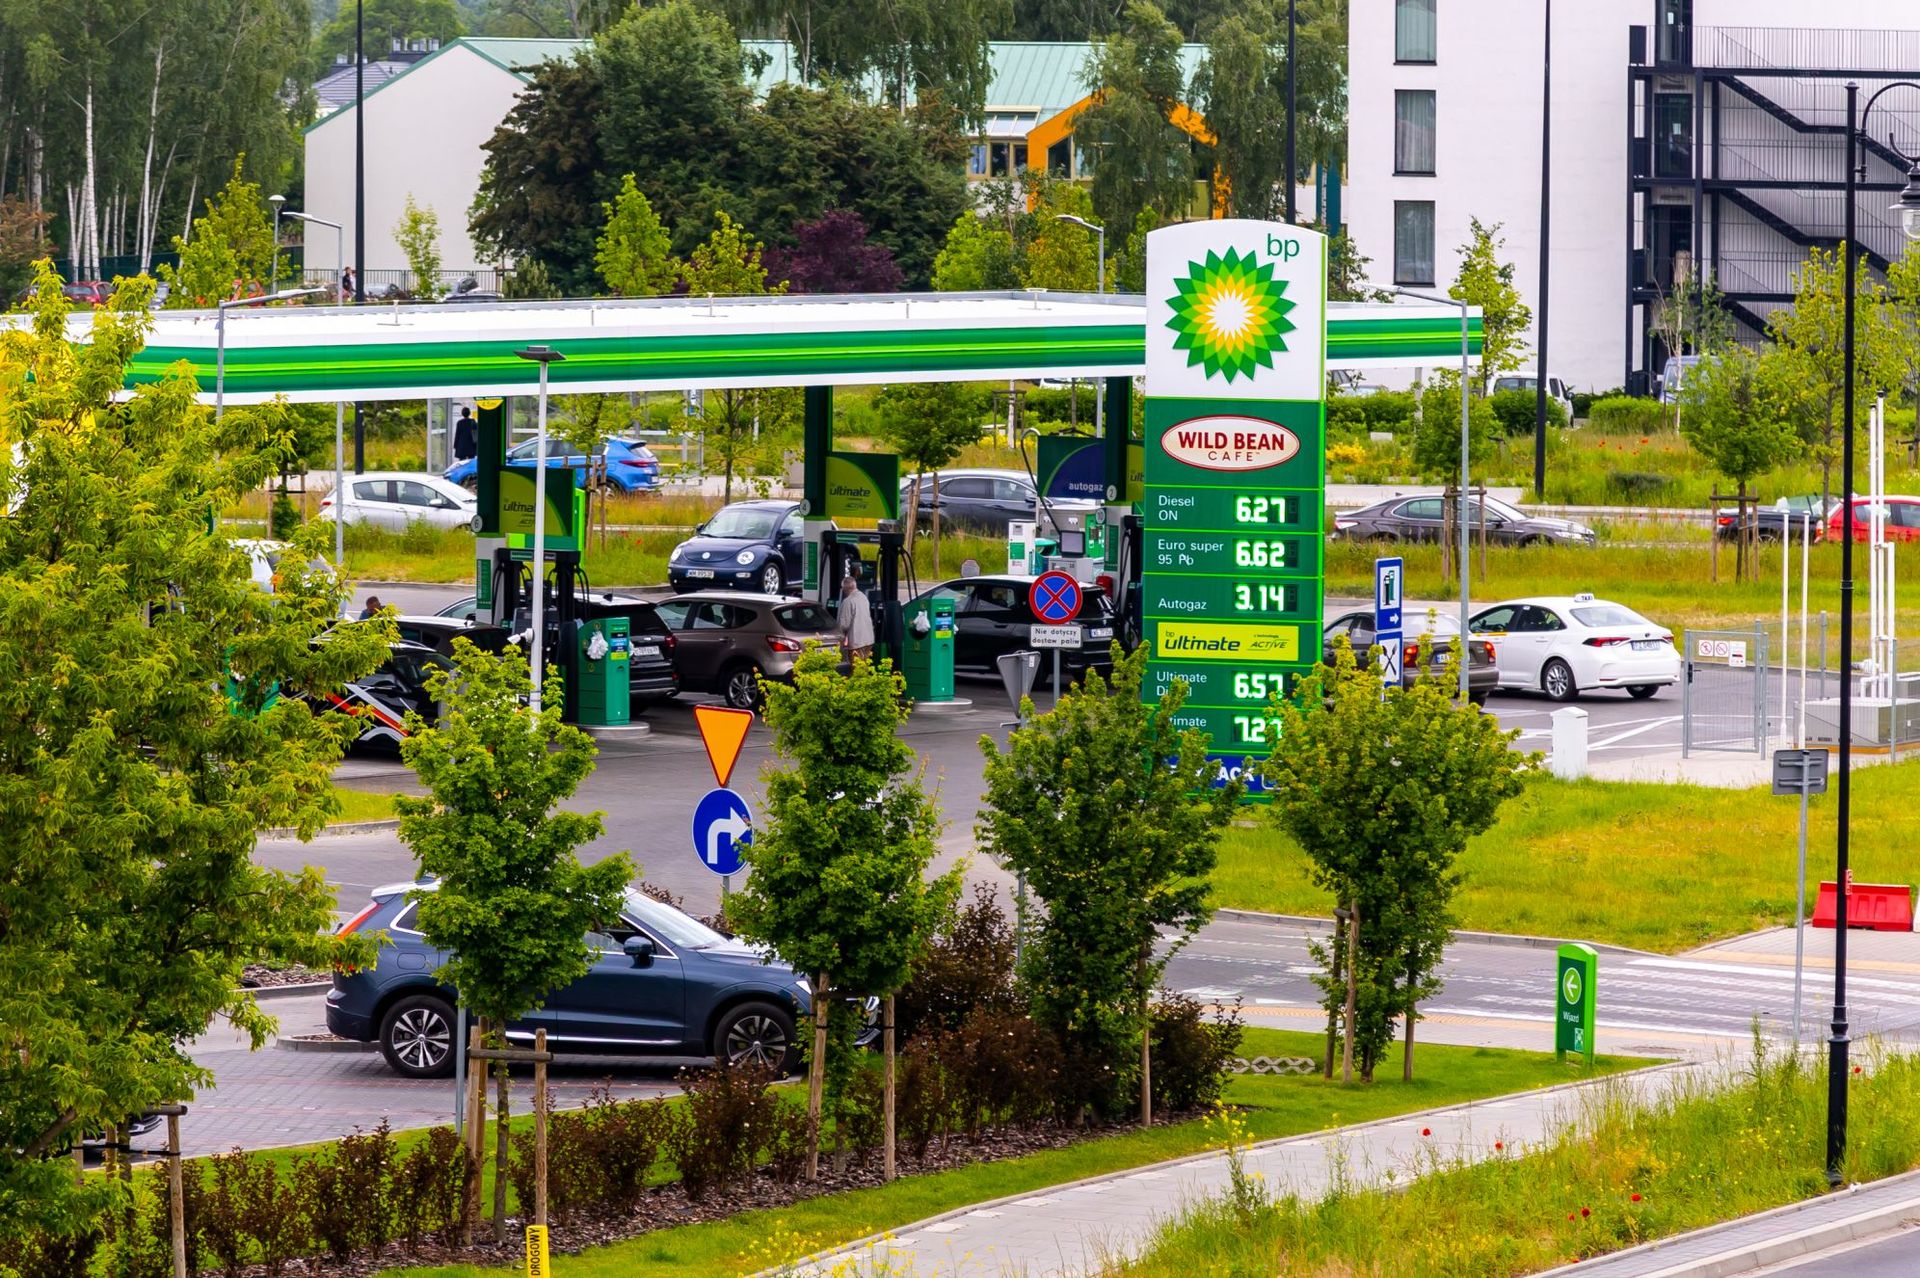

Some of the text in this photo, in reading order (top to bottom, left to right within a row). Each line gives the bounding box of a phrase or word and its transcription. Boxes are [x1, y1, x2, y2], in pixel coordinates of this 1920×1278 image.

[1267, 232, 1300, 262] bp
[1178, 431, 1285, 451] WILD BEAN
[829, 485, 871, 497] ultimate
[1068, 482, 1104, 493] autogaz
[503, 501, 537, 513] ultima
[1158, 494, 1195, 507] Diesel
[1158, 509, 1179, 521] ON
[1236, 496, 1286, 524] 6.27
[1158, 538, 1225, 553] Euro super
[1157, 553, 1173, 565] 95
[1235, 541, 1286, 568] 6.62
[1157, 597, 1208, 612] Autogaz
[1235, 584, 1285, 612] 3.14
[1050, 628, 1077, 637] dotyczy
[1165, 629, 1176, 638] bp
[1060, 637, 1080, 646] paliw
[1164, 635, 1241, 652] ultimate
[1250, 641, 1288, 649] ACTIVE
[1156, 671, 1208, 683] Ultimate
[1234, 673, 1284, 699] 6.57
[528, 1227, 541, 1276] DROGOWY
